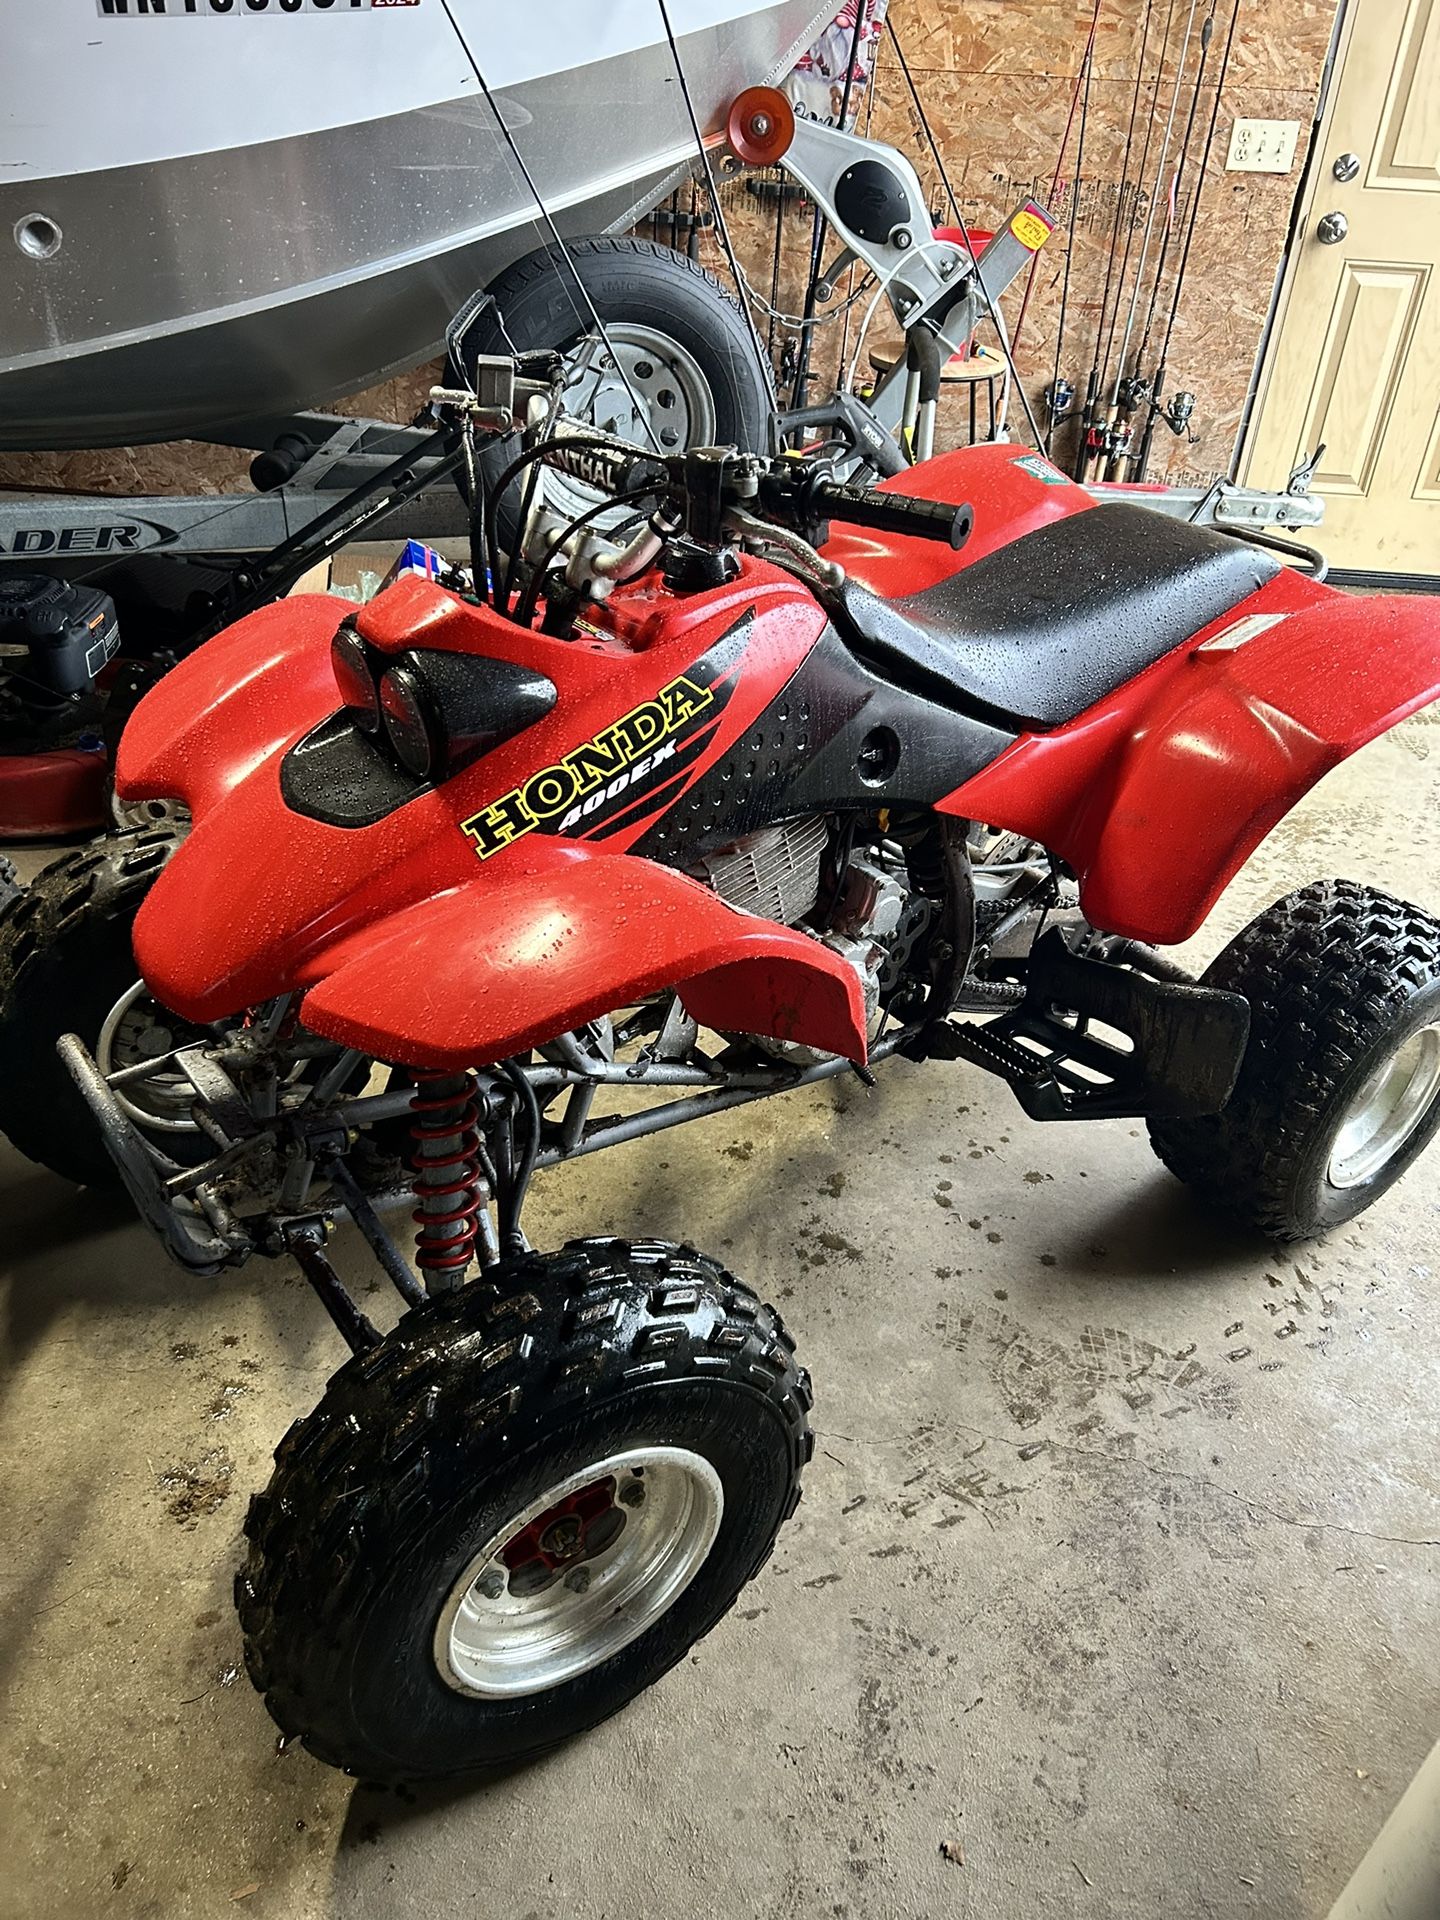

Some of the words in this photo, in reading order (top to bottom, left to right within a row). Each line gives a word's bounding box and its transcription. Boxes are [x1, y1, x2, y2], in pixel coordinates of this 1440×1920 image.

[862, 421, 885, 450] RYOBI
[460, 675, 714, 860] HONDA
[558, 738, 677, 831] 400EX
